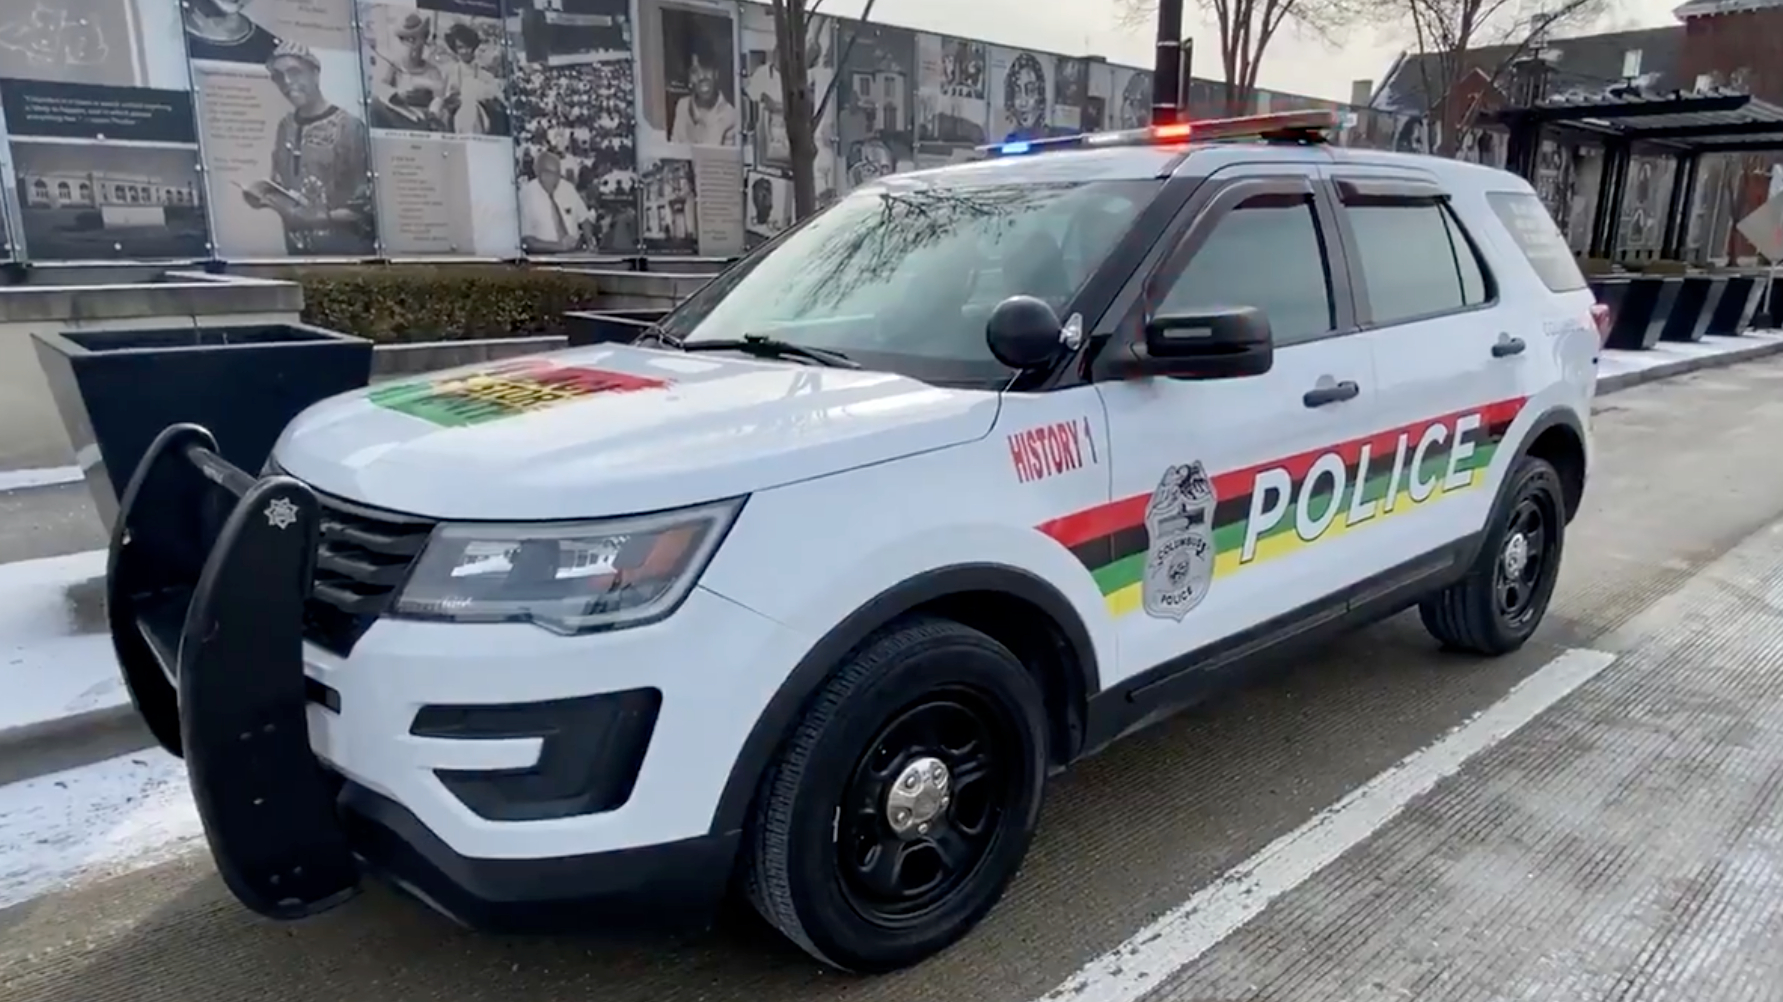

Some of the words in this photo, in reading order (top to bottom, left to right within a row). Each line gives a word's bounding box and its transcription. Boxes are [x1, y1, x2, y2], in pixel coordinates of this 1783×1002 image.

[1007, 419, 1083, 483] HISTORY
[1084, 415, 1098, 464] 1
[1239, 412, 1482, 565] POLICE
[1156, 536, 1207, 561] COLUMBUS
[1160, 585, 1193, 606] POLICE
